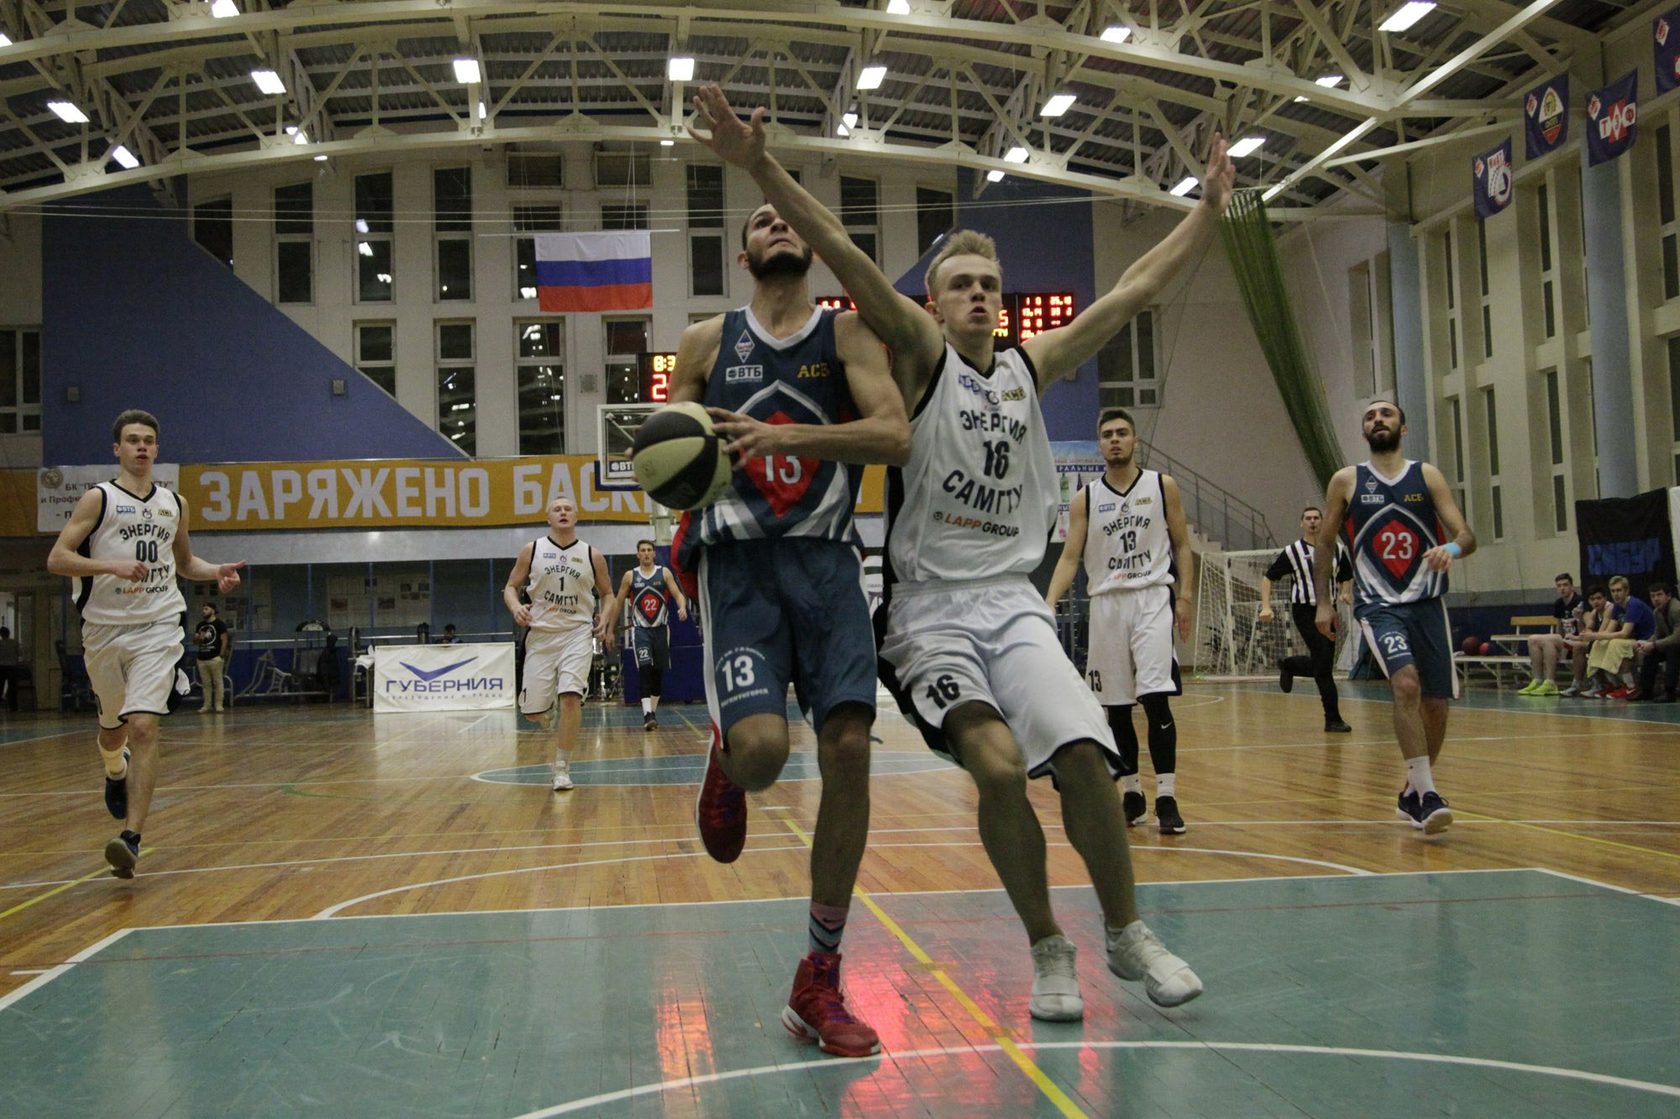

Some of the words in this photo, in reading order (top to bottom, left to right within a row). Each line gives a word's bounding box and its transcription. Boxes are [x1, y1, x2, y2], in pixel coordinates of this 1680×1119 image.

[653, 355, 676, 372] 8:3
[738, 366, 762, 378] ВТБ
[797, 362, 830, 379] АСБ
[652, 374, 667, 399] 2
[960, 410, 1028, 445] ЭНЕРГИЯ
[983, 441, 1010, 480] 16
[1059, 465, 1099, 473] РАЛЬНЫЕ
[200, 467, 490, 522] ЗАРЯЖЕНО
[513, 463, 653, 514] БАСК
[942, 470, 1022, 515] САМГТУ
[119, 523, 170, 543] ЭНЕРГИЯ
[944, 513, 982, 529] LAPP
[982, 522, 1019, 537] GROUP
[1102, 515, 1150, 536] ЭНЕРГИЯ
[136, 540, 158, 563] 00
[1120, 530, 1136, 553] 13
[1381, 532, 1413, 559] 23
[544, 564, 581, 580] ЭНЕРГИЯ
[558, 576, 565, 592] 1
[544, 590, 579, 606] САМГТУ
[643, 599, 657, 611] 22
[638, 649, 649, 659] 22
[1384, 636, 1408, 654] 23
[722, 655, 755, 693] 13
[1089, 670, 1102, 692] 13
[386, 677, 503, 693] ГУБЕРНИЯ
[925, 674, 960, 710] 16
